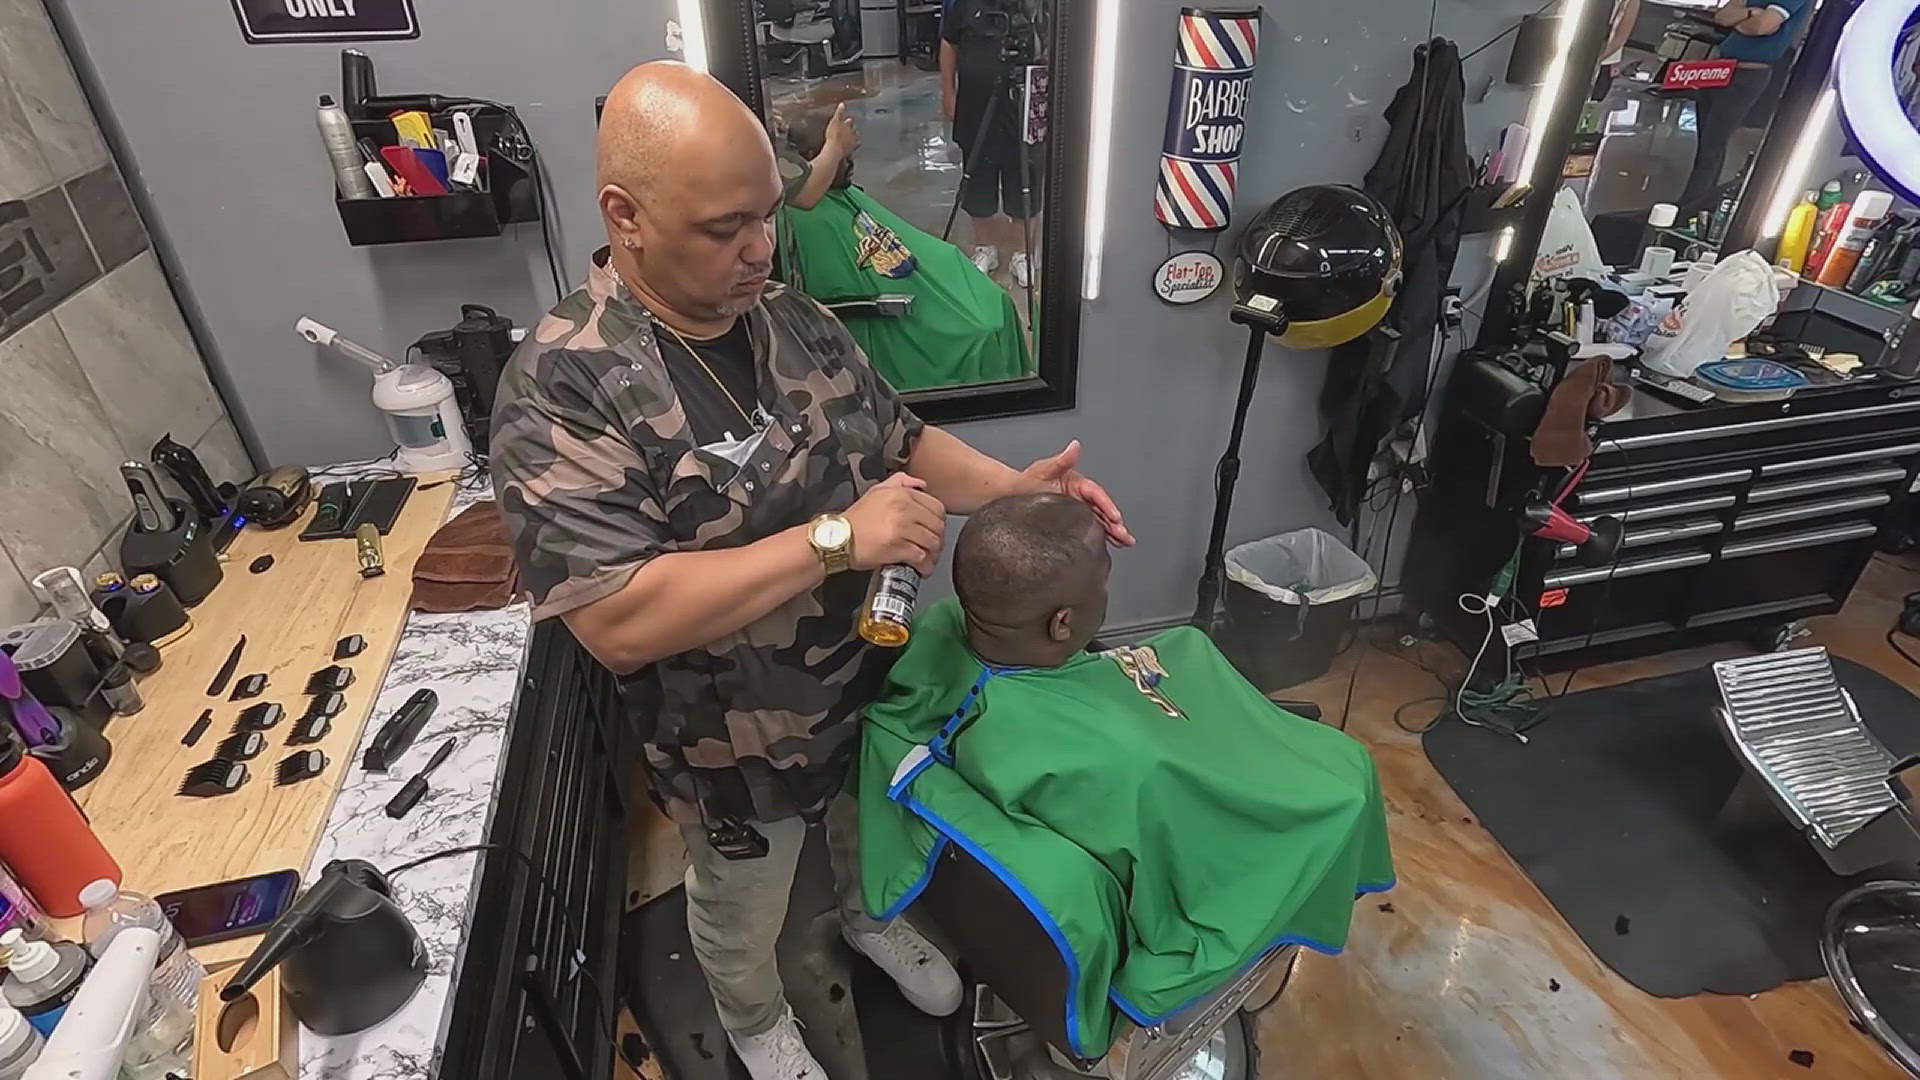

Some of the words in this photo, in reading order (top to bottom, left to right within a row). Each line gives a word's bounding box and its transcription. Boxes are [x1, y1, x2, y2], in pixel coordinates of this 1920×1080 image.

[284, 0, 356, 18] ONLY
[1669, 64, 1730, 86] Supreme
[1192, 123, 1244, 154] SHOP
[1166, 261, 1213, 281] Flat-Top
